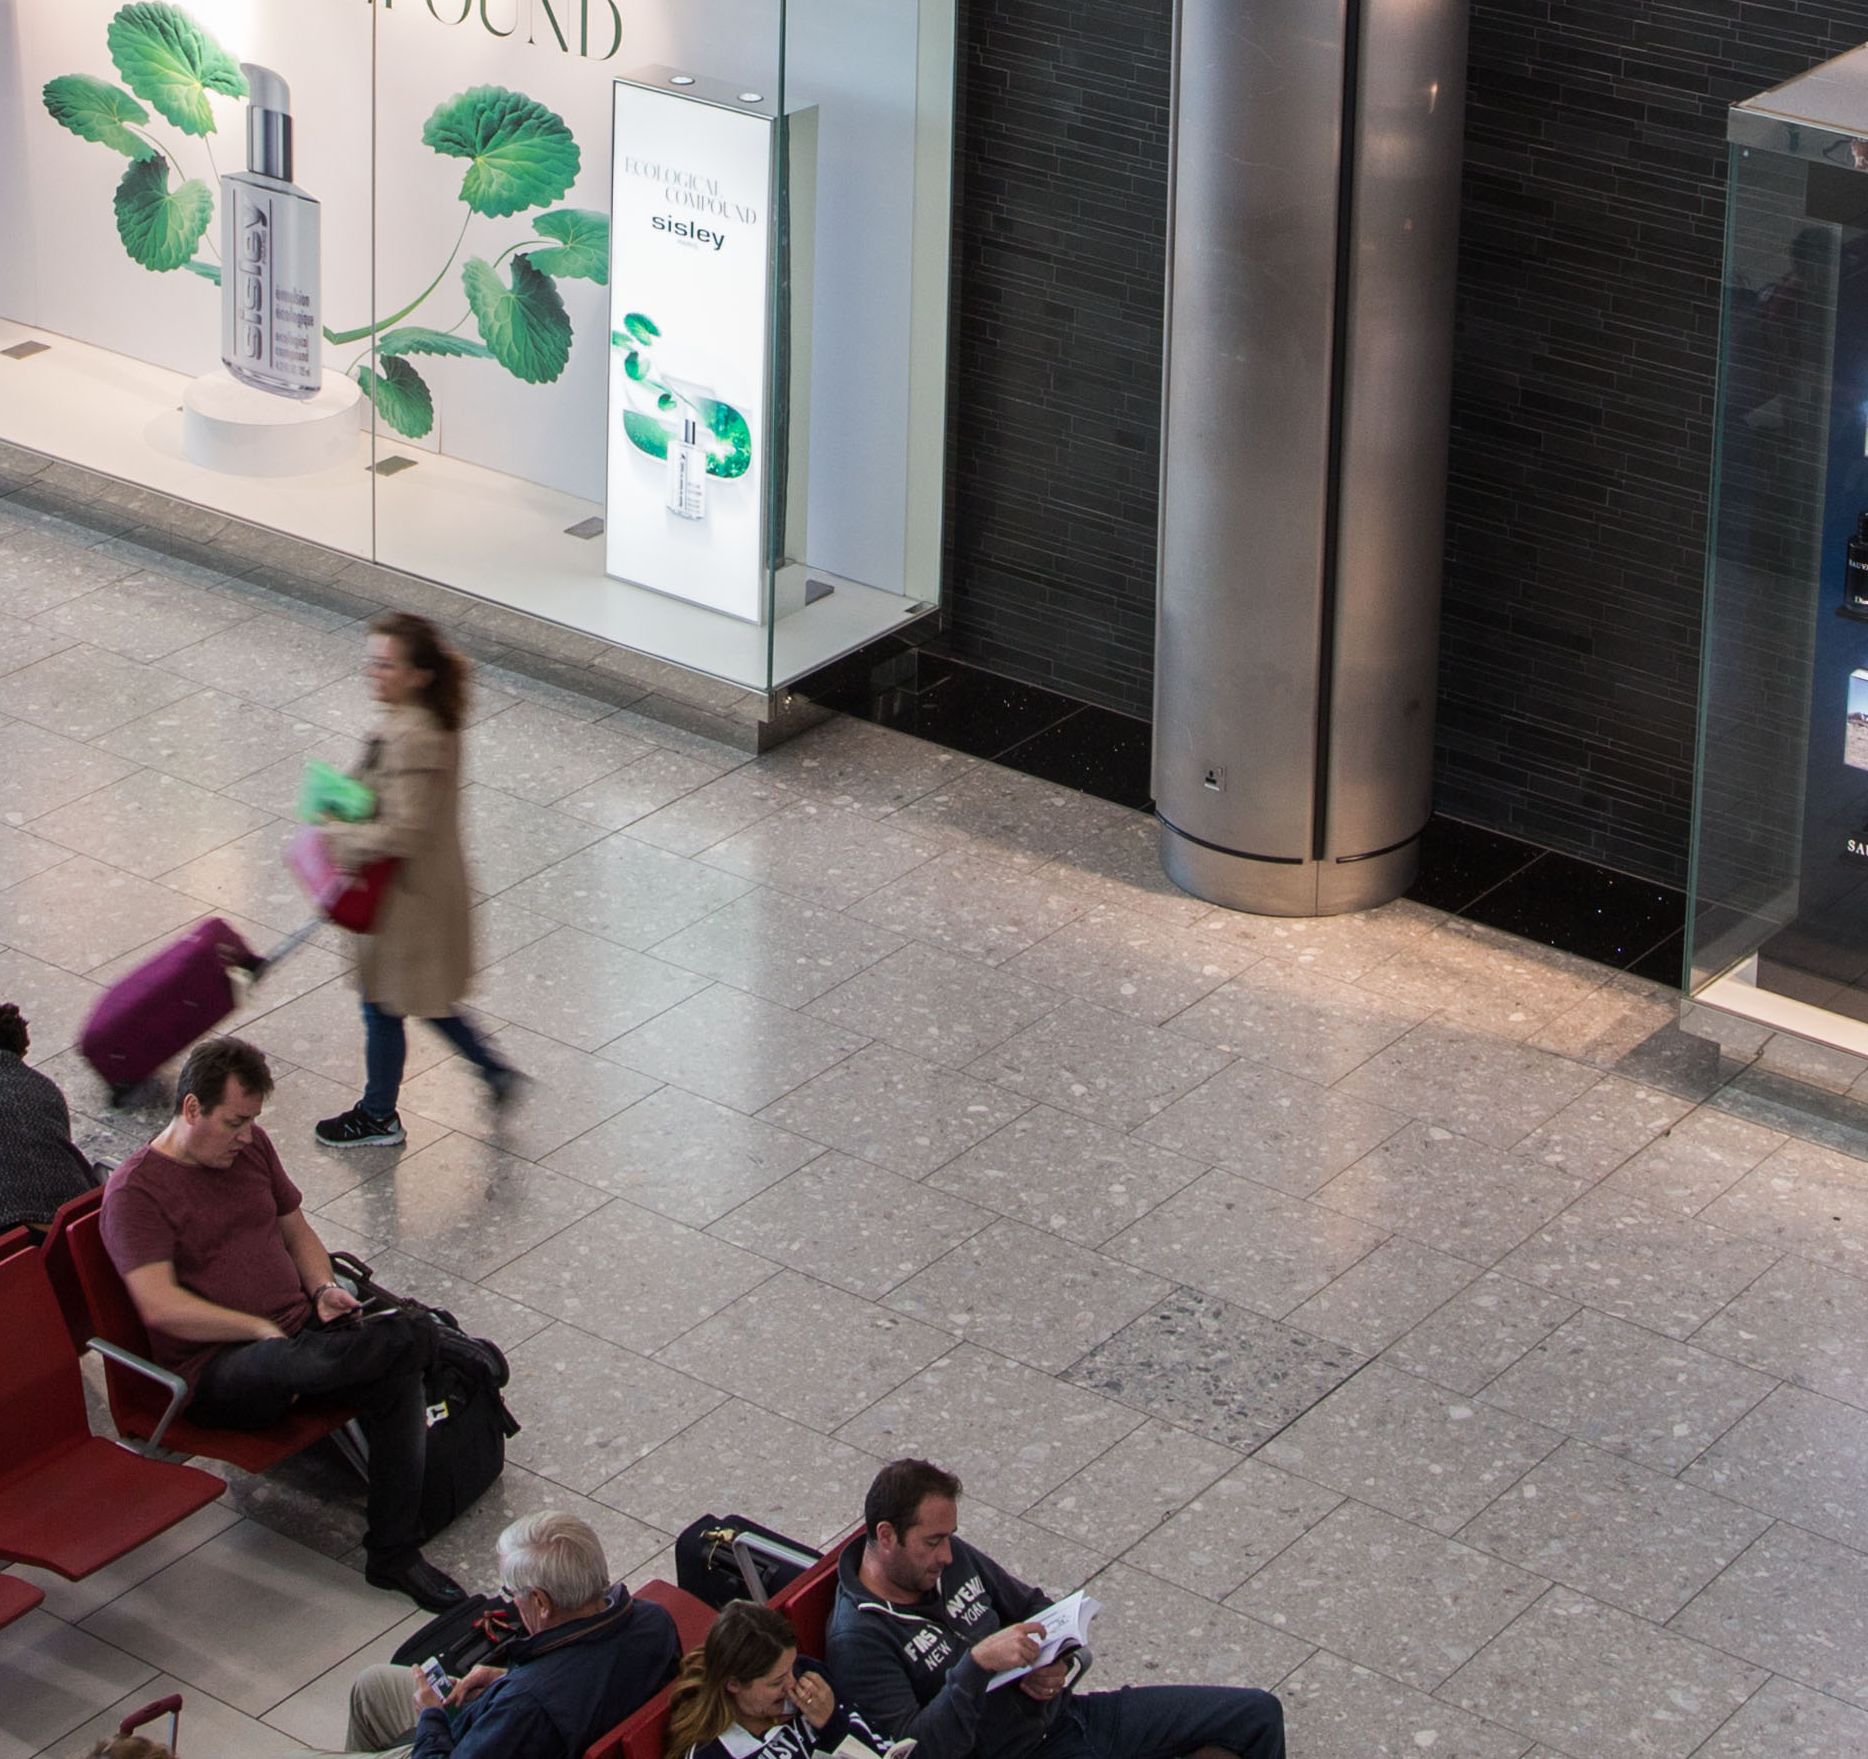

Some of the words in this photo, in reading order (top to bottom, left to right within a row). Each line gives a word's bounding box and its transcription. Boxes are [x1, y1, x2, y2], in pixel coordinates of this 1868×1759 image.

[625, 155, 725, 199] ECOLOGICAL
[665, 187, 757, 225] COMPOUND
[651, 214, 725, 251] sisley
[240, 196, 268, 361] sisley
[946, 1575, 986, 1619] AVENU
[924, 1640, 953, 1672] NEW
